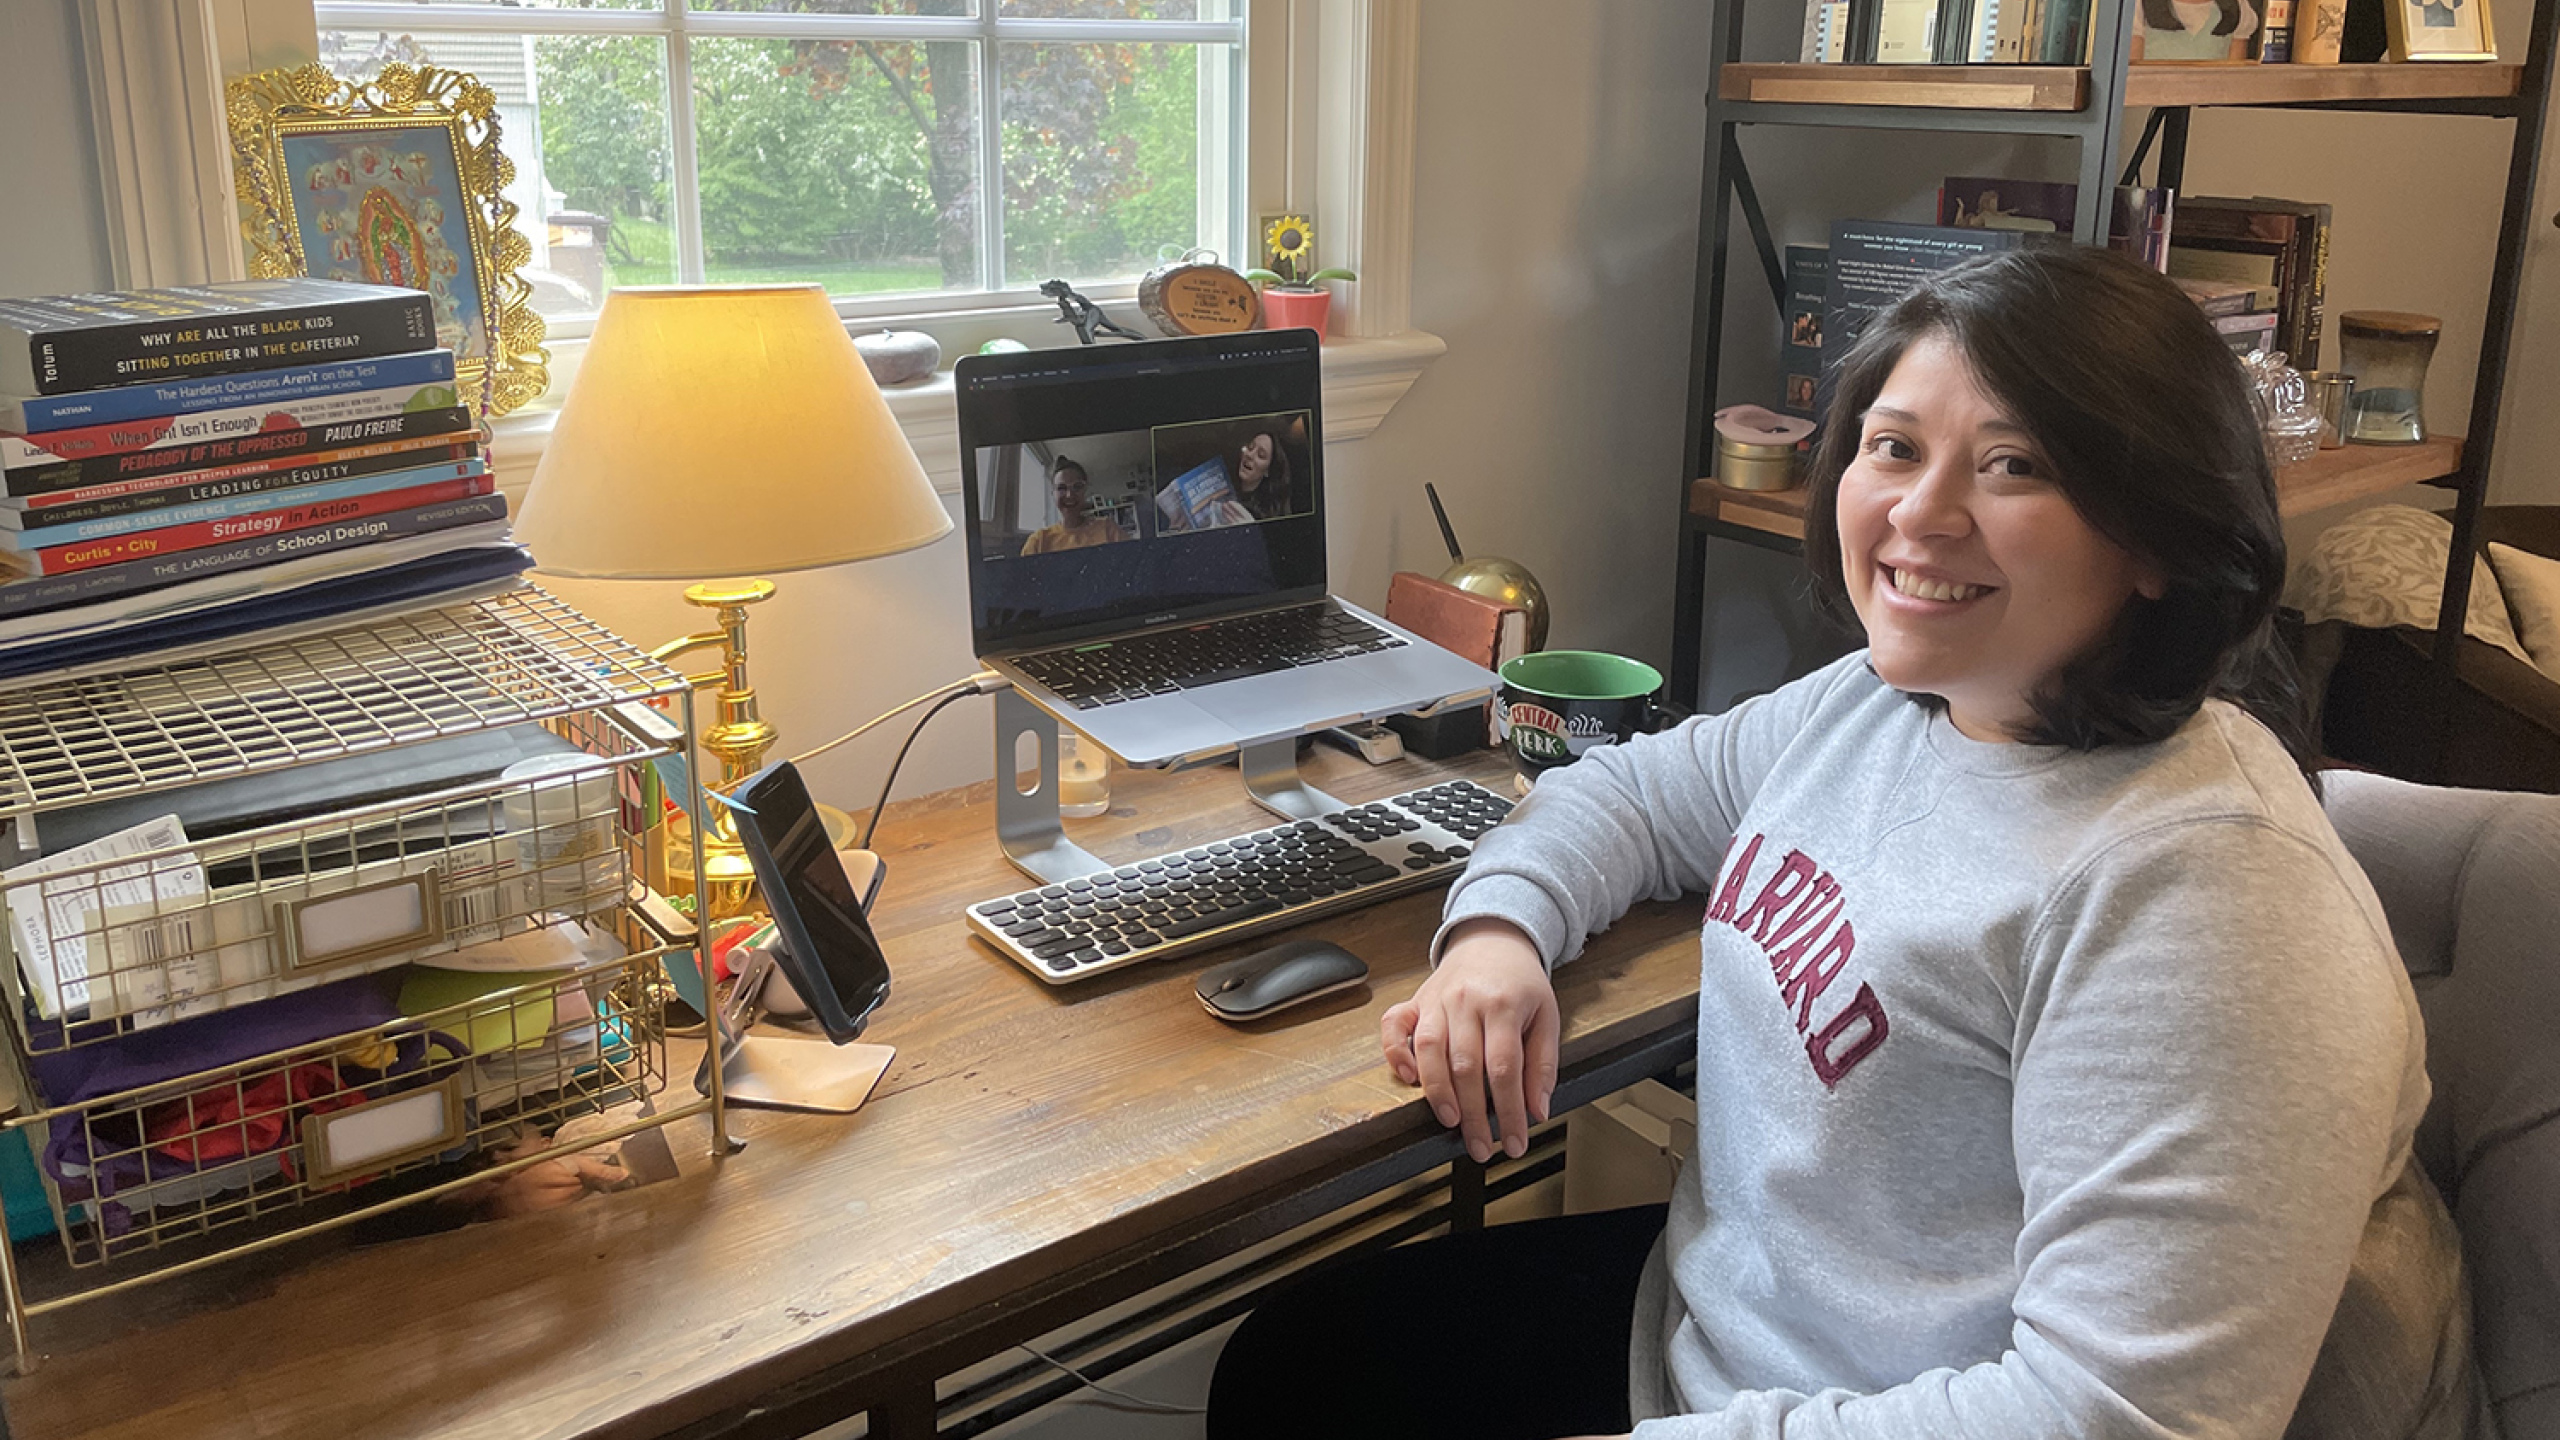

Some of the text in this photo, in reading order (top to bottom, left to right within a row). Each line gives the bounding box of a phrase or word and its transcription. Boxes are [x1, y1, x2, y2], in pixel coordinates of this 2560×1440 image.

[140, 315, 334, 347] WHY ARE ALL THE BLACK KIDS
[43, 343, 58, 383] Tatum
[116, 334, 361, 374] SITTING TOGETHER IN THE CAFETERIA?
[155, 364, 377, 401] The Hardest Questions Aren't on the Test
[52, 404, 92, 417] NATHAN
[109, 415, 257, 447] When Grit Isn't Enough
[324, 417, 404, 442] PAULO FREIRE
[120, 431, 308, 473] PEDAGOGY OF THE OPPRESSED
[189, 464, 349, 500] LEADING FOR EQUITY
[78, 504, 227, 536] COMMON-SENSE EVIDENCE
[212, 502, 359, 538] Strategy in Action
[416, 502, 492, 523] REVISED EDITION
[64, 539, 158, 564] Curtis City
[153, 520, 389, 577] THE LANGUAGE OF School Design
[1512, 706, 1560, 734] CENTRAL
[1516, 726, 1559, 756] PERK
[1702, 833, 1889, 1094] ARVARD
